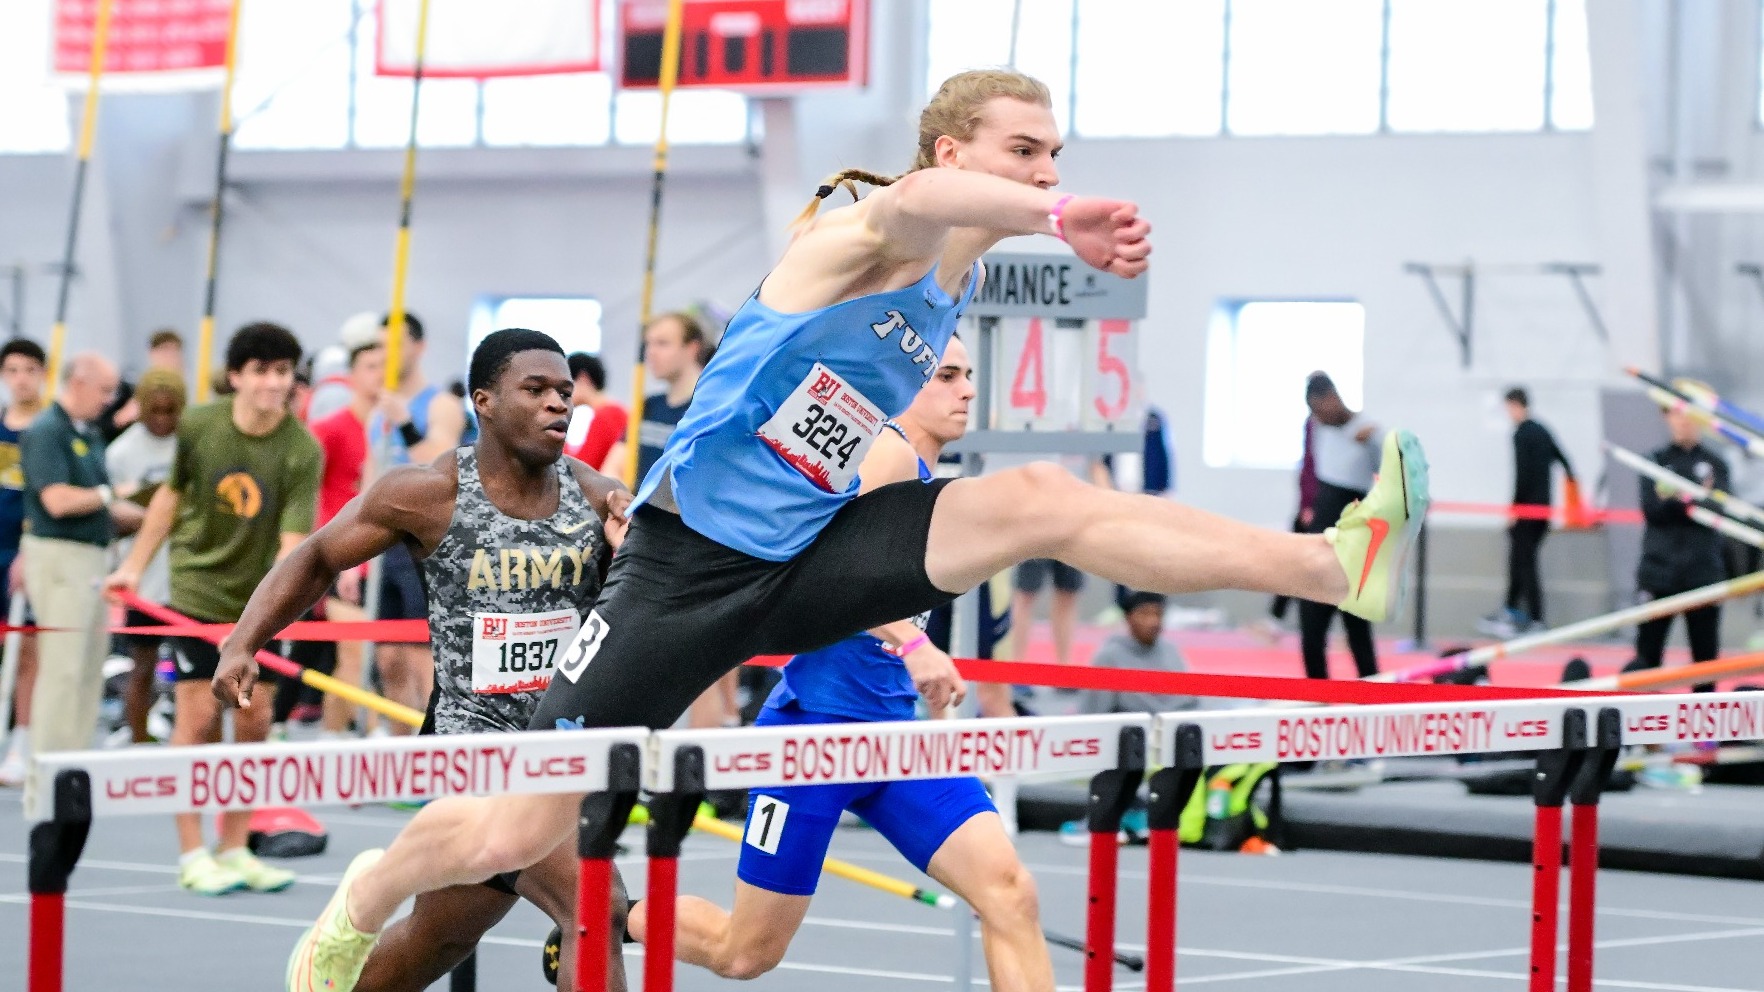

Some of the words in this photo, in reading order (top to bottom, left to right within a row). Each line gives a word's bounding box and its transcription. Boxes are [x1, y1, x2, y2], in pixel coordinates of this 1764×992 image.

[971, 263, 1071, 305] MANCE
[870, 309, 939, 388] TUFT
[1010, 316, 1047, 417] 4
[1094, 317, 1131, 420] 5
[810, 371, 842, 401] BU
[792, 403, 861, 470] 3224
[467, 546, 593, 591] ARMY
[482, 617, 508, 637] BU
[563, 617, 601, 672] 3
[498, 639, 558, 673] 1837
[1212, 731, 1261, 750] UCS
[1277, 716, 1367, 759] BOSTON
[1374, 711, 1496, 755] UNIVERSITY
[1504, 719, 1549, 738] UCS
[1627, 714, 1668, 732] UCS
[1677, 701, 1757, 739] BOSTON
[106, 776, 178, 799] UCS
[190, 755, 324, 807] BOSTON
[336, 746, 517, 800] UNIVERSITY
[524, 755, 588, 778] UCS
[715, 753, 772, 772] UCS
[783, 735, 890, 781] BOSTON
[900, 729, 1044, 776] UNIVERSITY
[1050, 738, 1102, 757] UCS
[759, 801, 775, 848] 1
